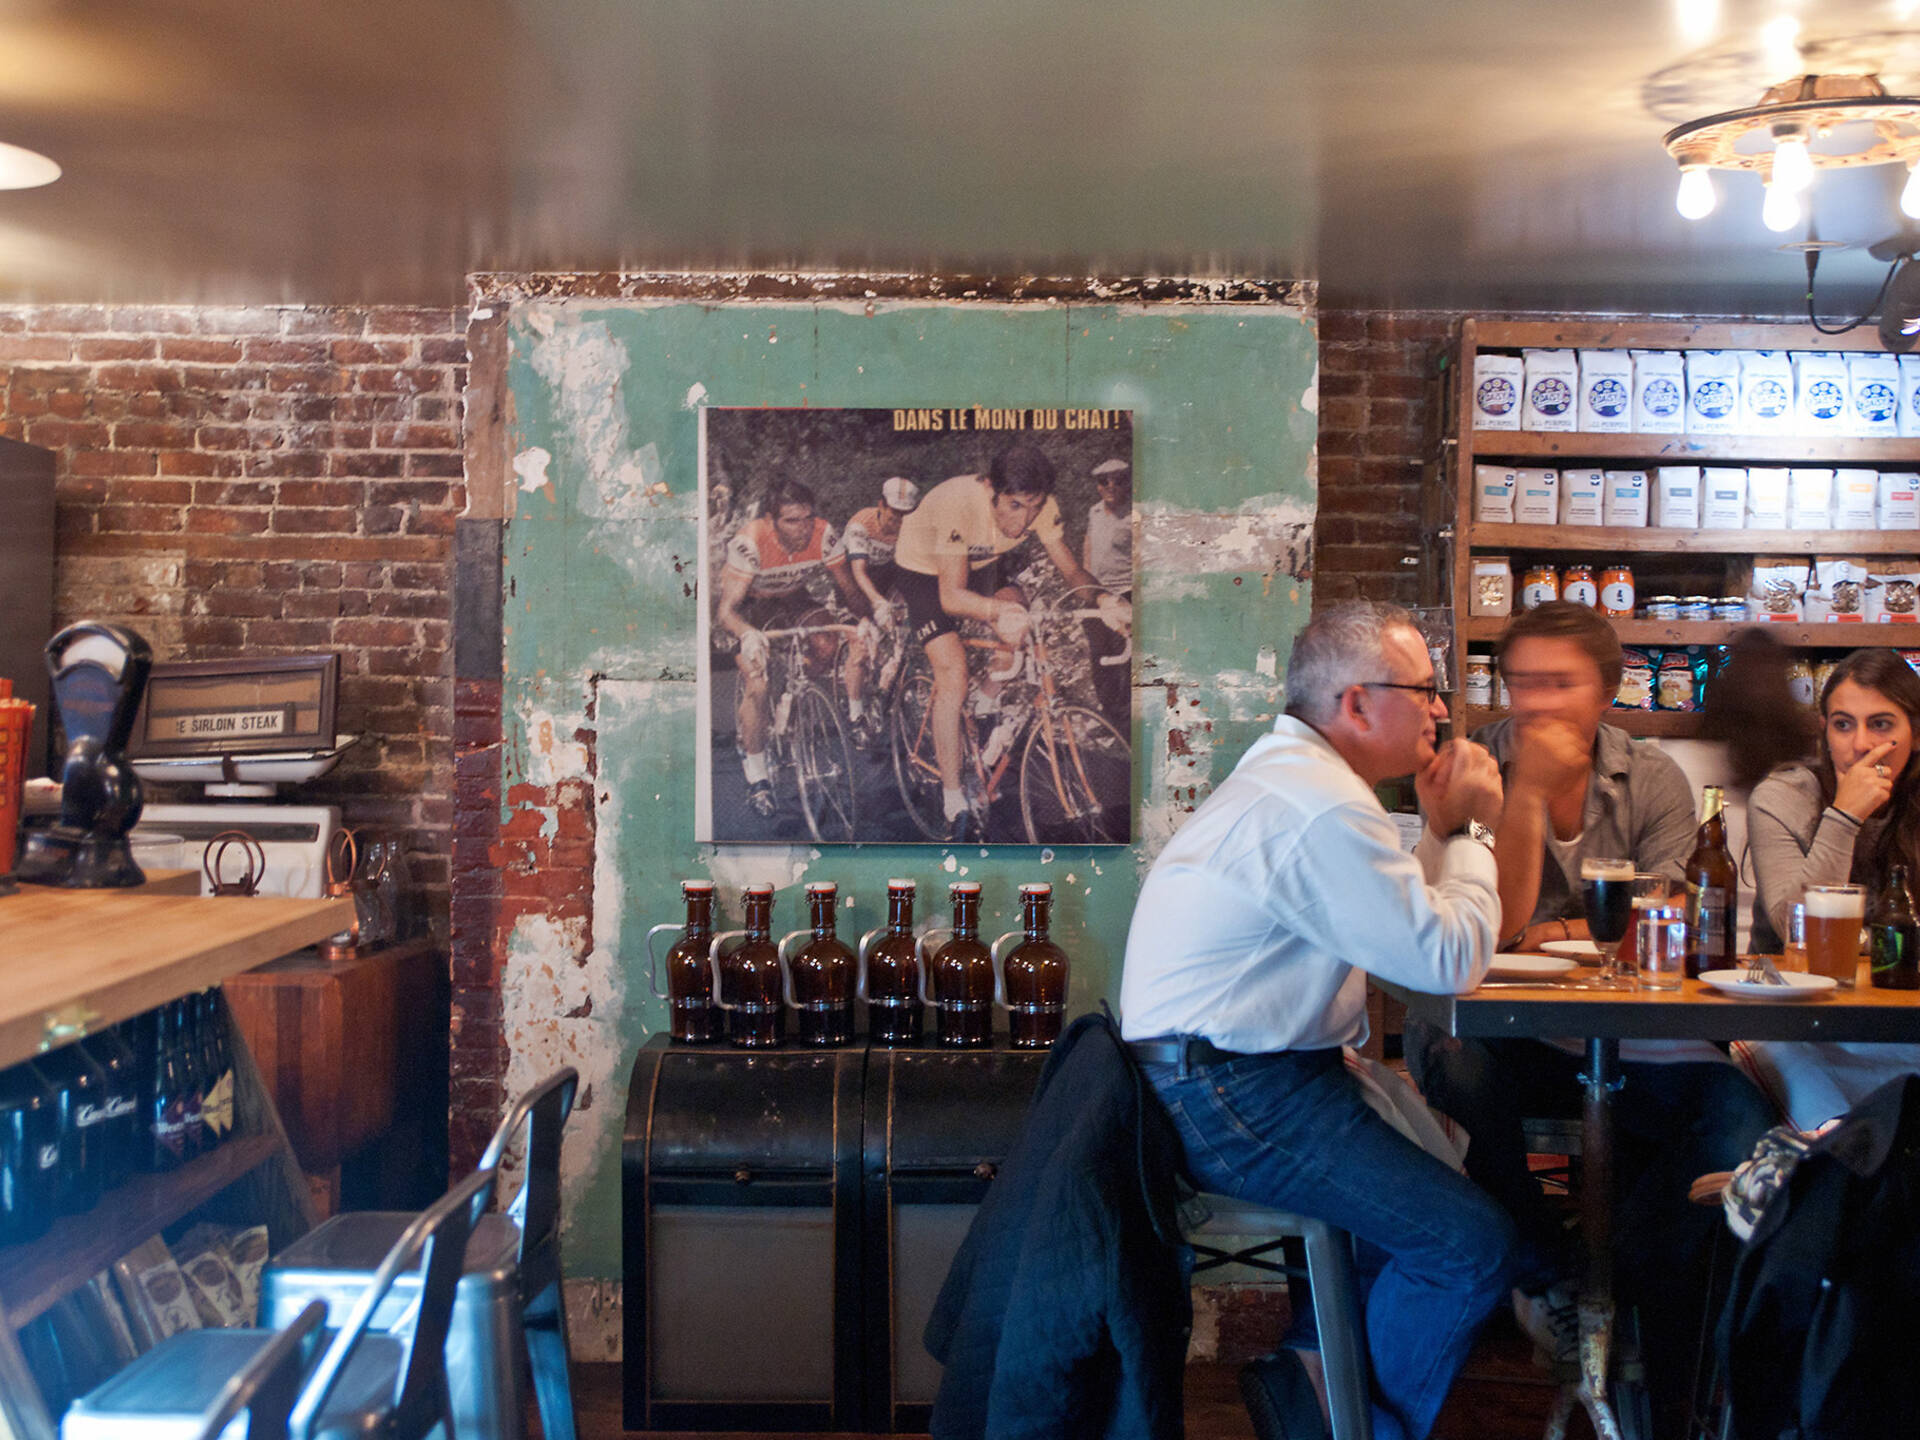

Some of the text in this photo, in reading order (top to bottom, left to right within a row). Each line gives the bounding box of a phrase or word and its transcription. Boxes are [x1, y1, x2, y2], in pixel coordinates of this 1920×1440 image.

[893, 409, 944, 431] DANS
[950, 409, 968, 430] LE
[974, 409, 1026, 430] MONT
[1033, 409, 1057, 430] DU
[192, 718, 236, 733] SIRLOIN
[241, 715, 278, 730] STEAK
